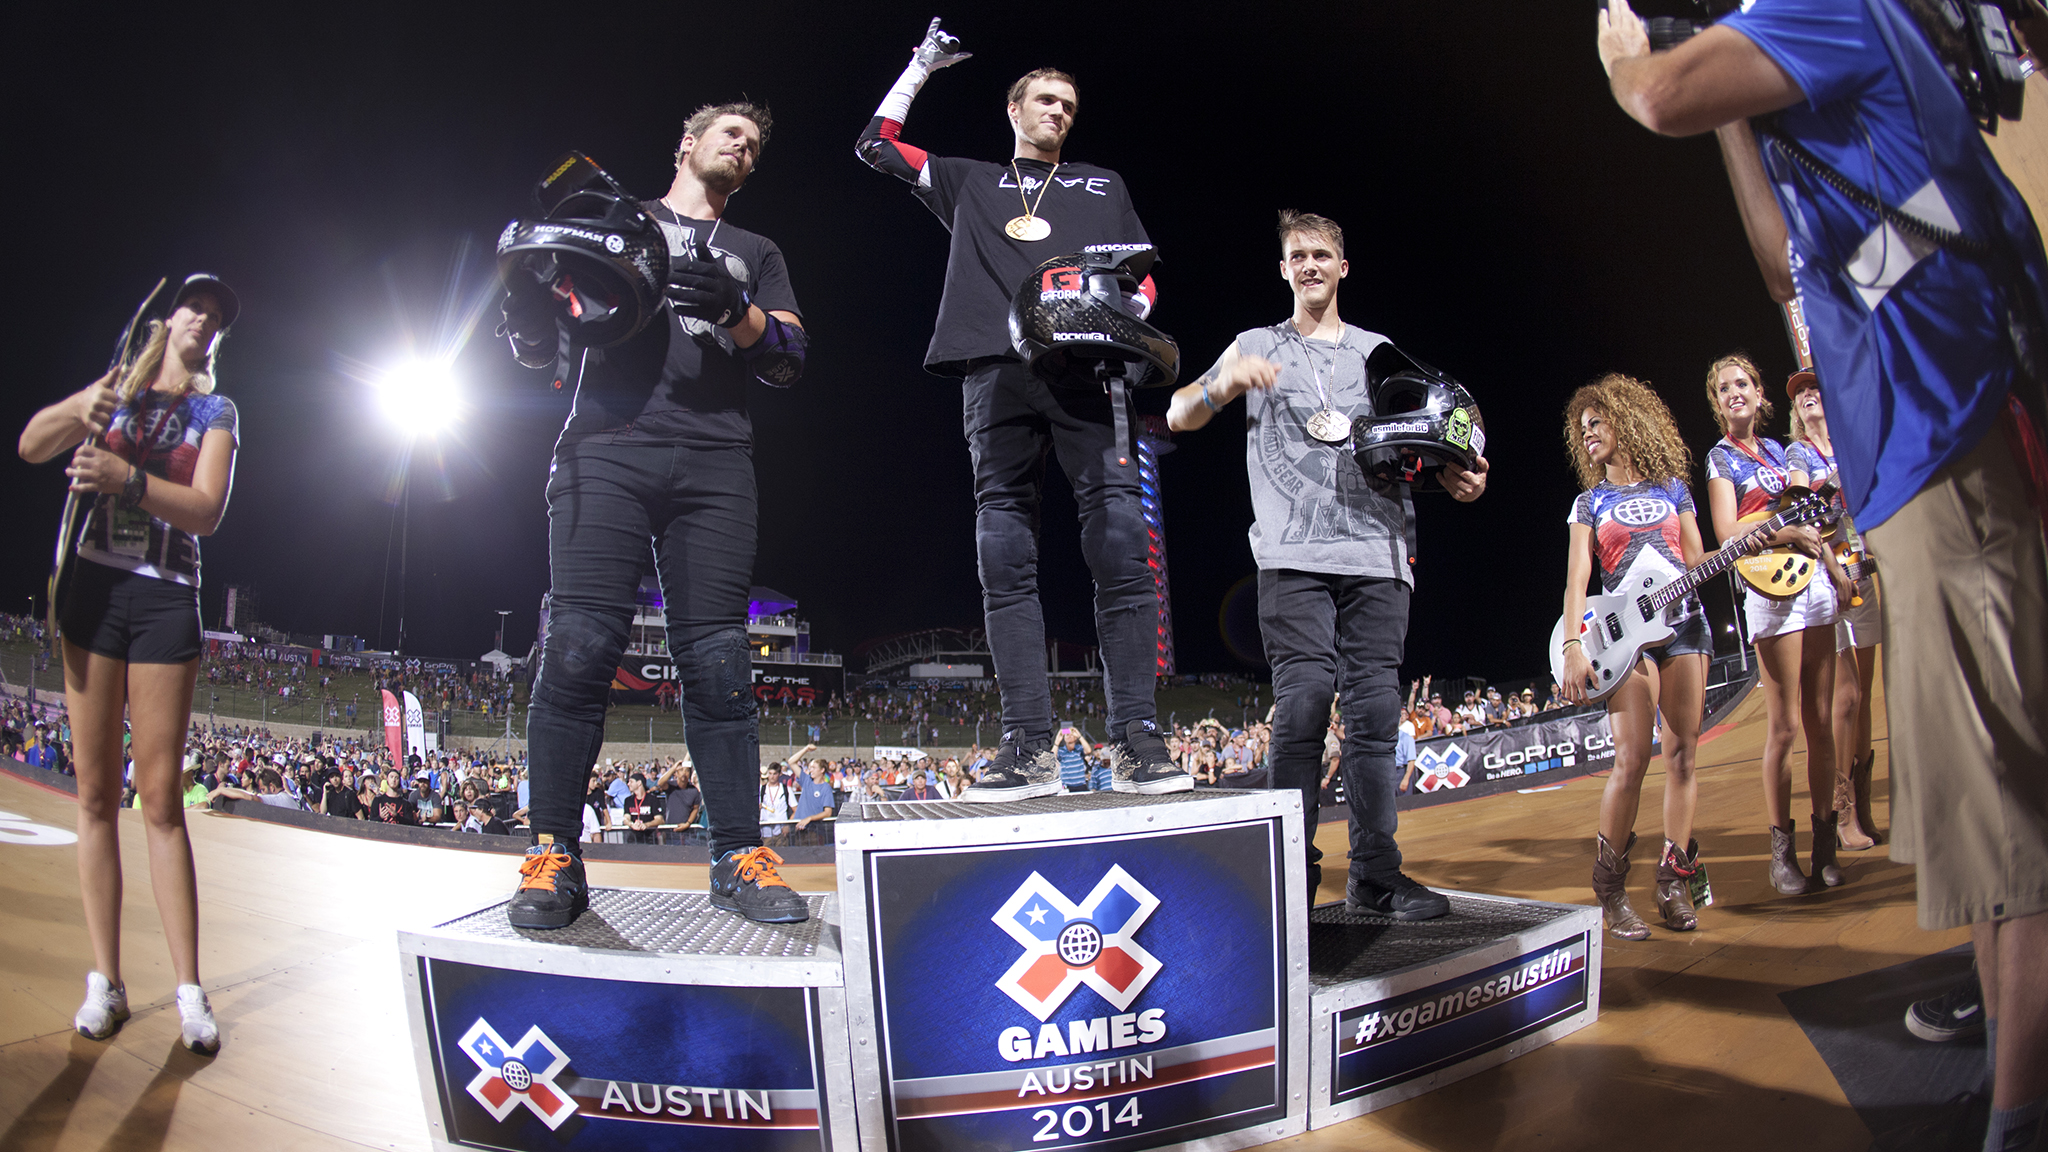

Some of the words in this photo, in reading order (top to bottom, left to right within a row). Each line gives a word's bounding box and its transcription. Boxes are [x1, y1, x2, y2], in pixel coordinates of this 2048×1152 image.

[763, 676, 781, 684] OF
[785, 677, 809, 685] THE
[1483, 742, 1576, 770] GoPro
[1354, 949, 1572, 1046] #xgamesaustin
[997, 1007, 1167, 1062] GAMES
[1018, 1055, 1155, 1099] AUSTIN
[600, 1080, 772, 1121] AUSTIN
[1032, 1096, 1143, 1142] 2014
